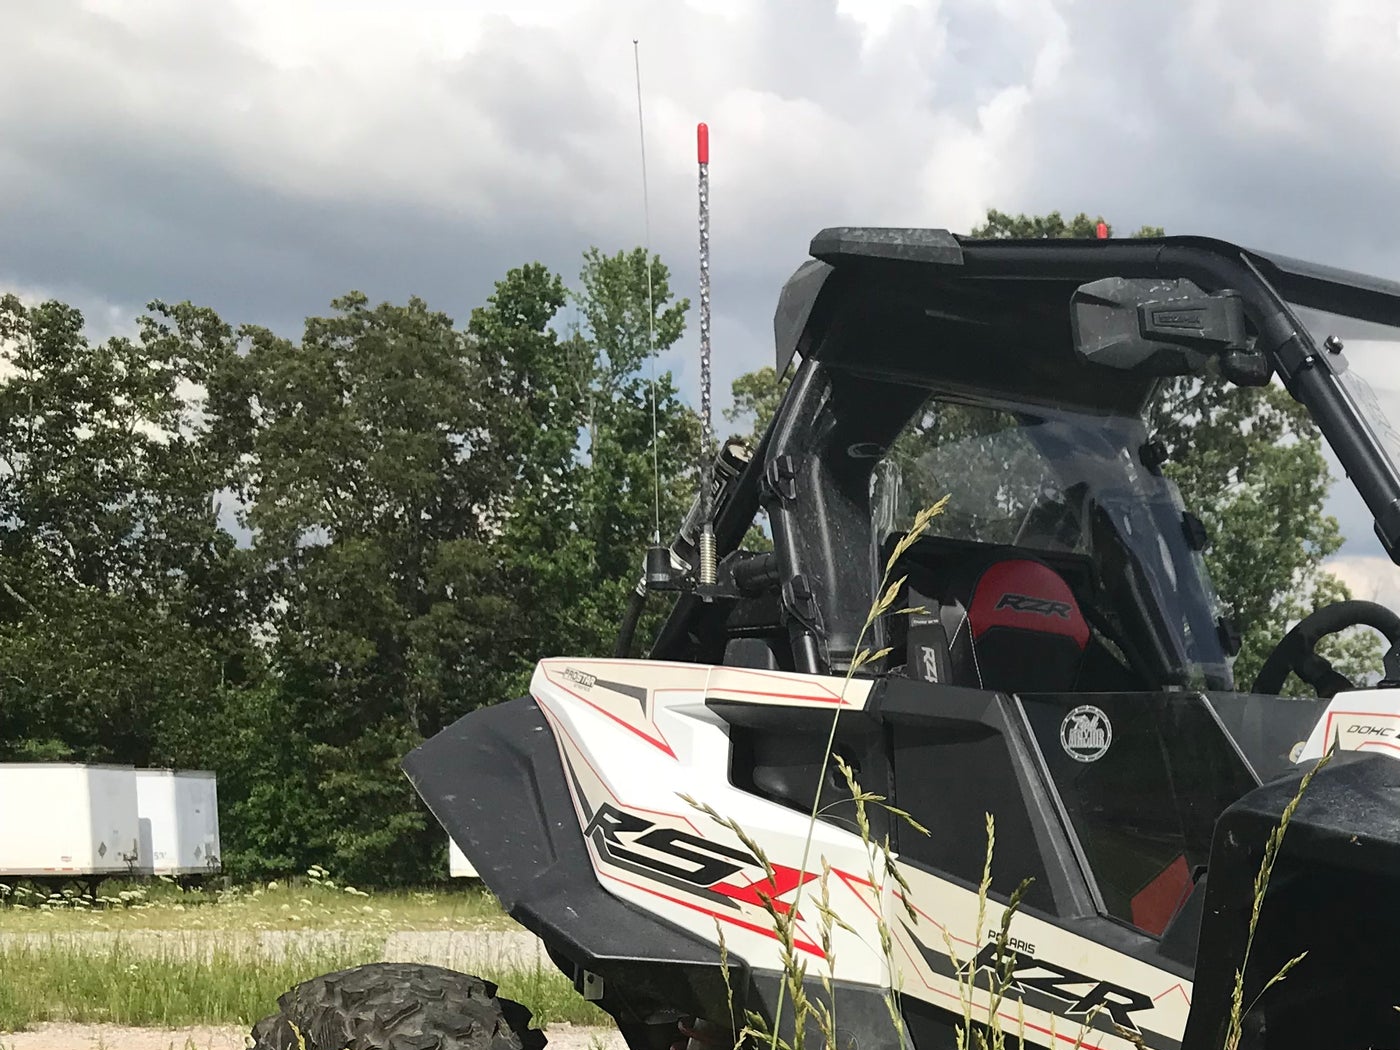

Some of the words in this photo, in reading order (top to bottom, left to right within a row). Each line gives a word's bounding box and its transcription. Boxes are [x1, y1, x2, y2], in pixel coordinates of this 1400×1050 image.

[993, 592, 1073, 620] RZR
[563, 667, 597, 688] PROSTAR
[1346, 724, 1396, 737] DOHC
[987, 929, 1036, 955] POARIS
[955, 941, 1156, 1036] RZR
